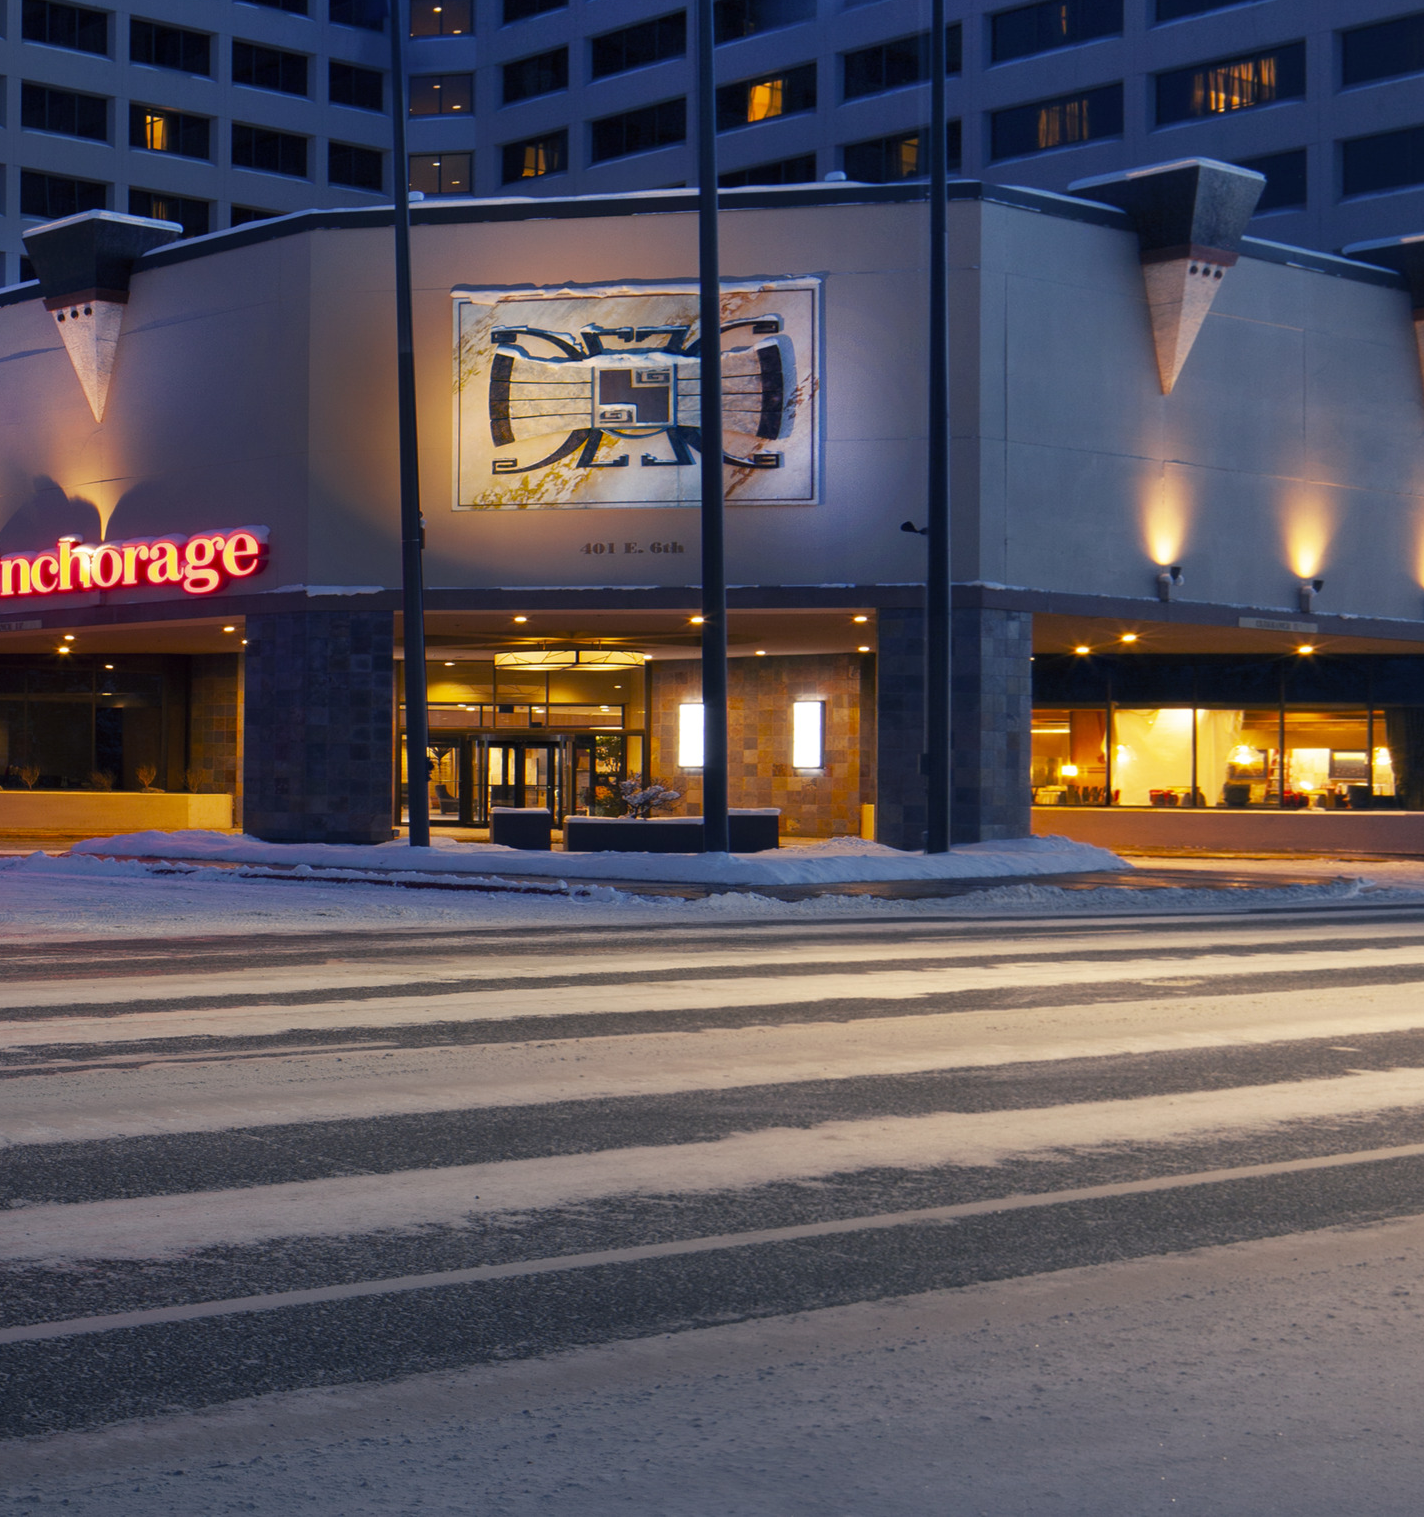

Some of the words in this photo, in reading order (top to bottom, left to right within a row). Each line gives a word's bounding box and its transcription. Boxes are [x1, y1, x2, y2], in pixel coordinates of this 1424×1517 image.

[580, 542, 615, 555] 401
[624, 542, 644, 554] E.
[649, 541, 684, 554] 6th
